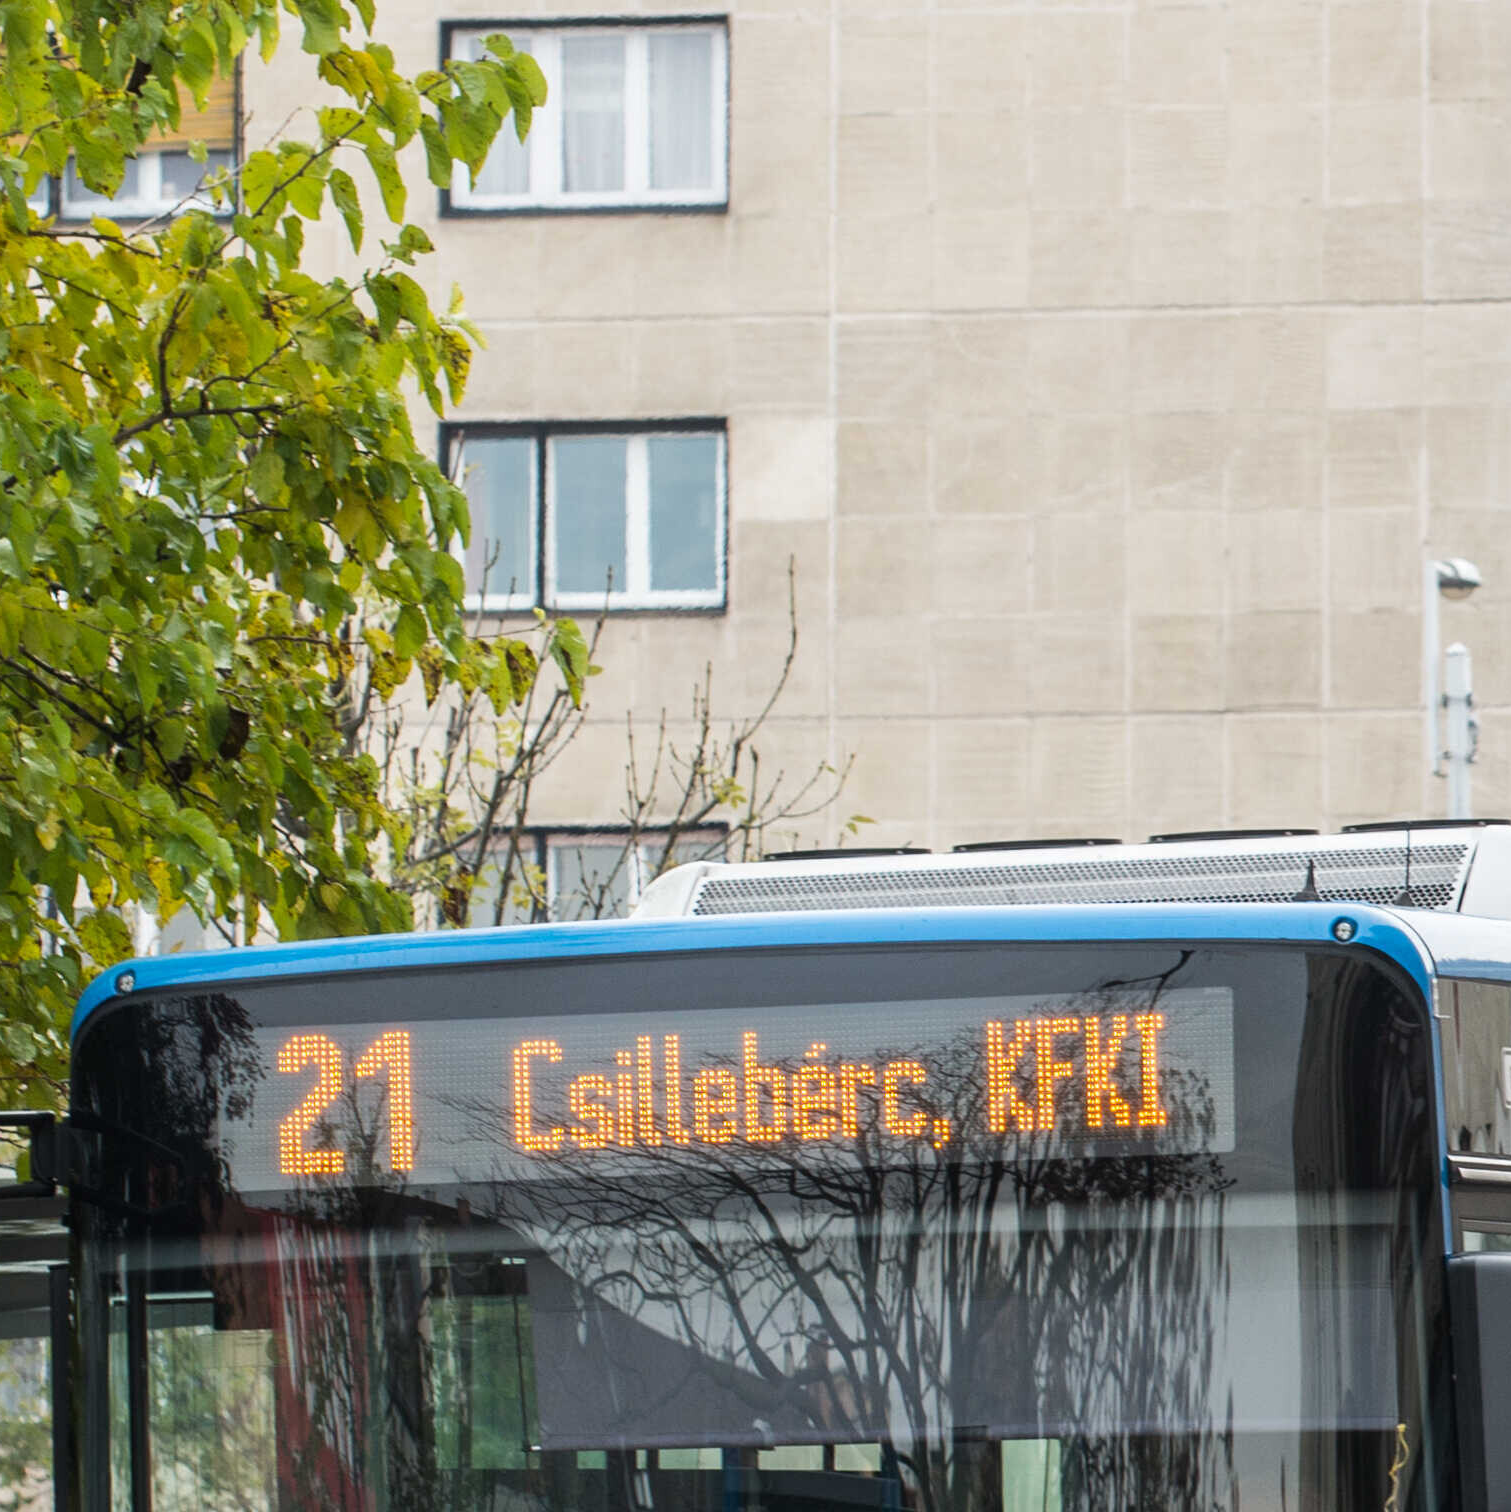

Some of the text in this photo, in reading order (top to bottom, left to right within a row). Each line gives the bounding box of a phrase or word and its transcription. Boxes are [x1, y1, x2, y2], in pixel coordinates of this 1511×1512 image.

[278, 1013, 1169, 1175] 21 Csillebérc, KFKI
